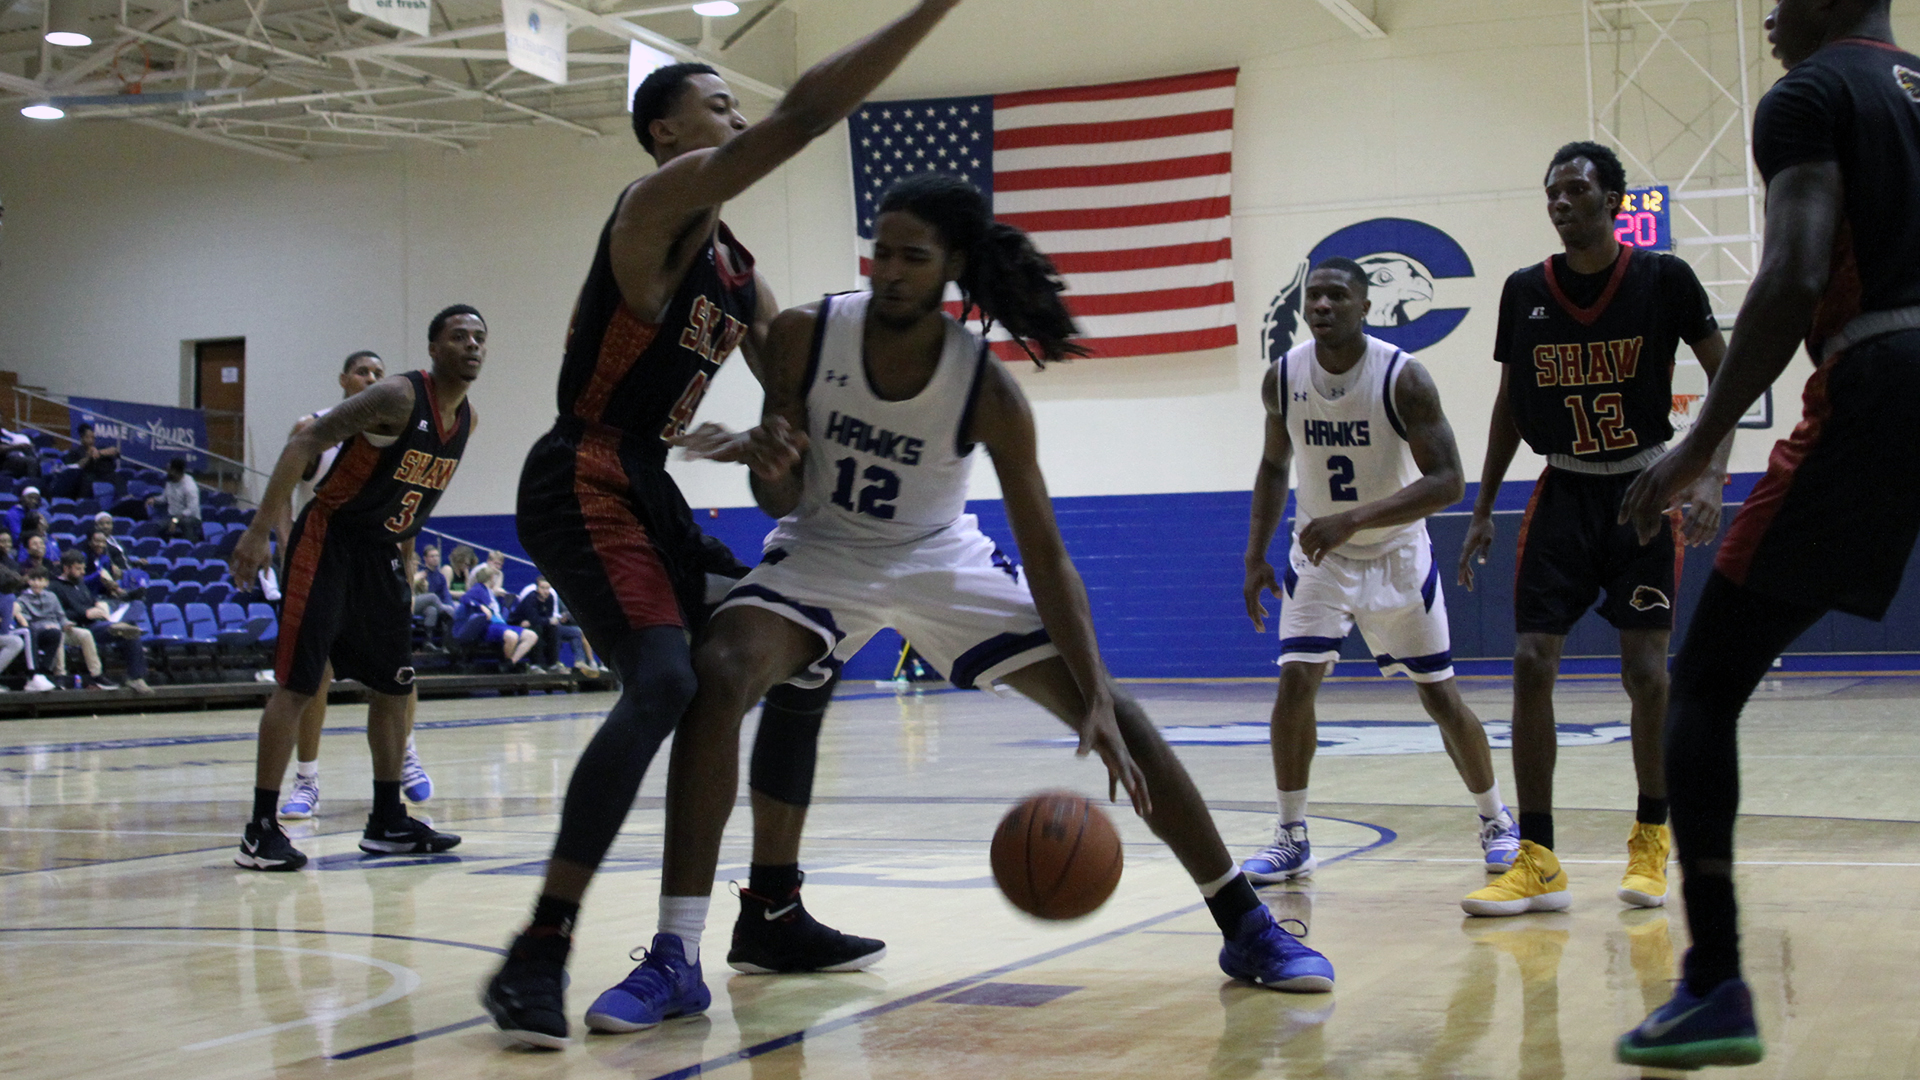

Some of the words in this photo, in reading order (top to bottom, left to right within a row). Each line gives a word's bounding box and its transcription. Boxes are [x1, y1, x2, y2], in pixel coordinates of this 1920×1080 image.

[1613, 211, 1657, 247] 20
[1533, 336, 1643, 387] SHAW
[825, 410, 925, 466] HAWKS
[1304, 419, 1371, 447] HAWKS
[1564, 392, 1639, 455] 12
[393, 449, 458, 491] SHAW
[831, 456, 902, 519] 12
[1327, 455, 1359, 501] 2
[384, 490, 423, 533] 3
